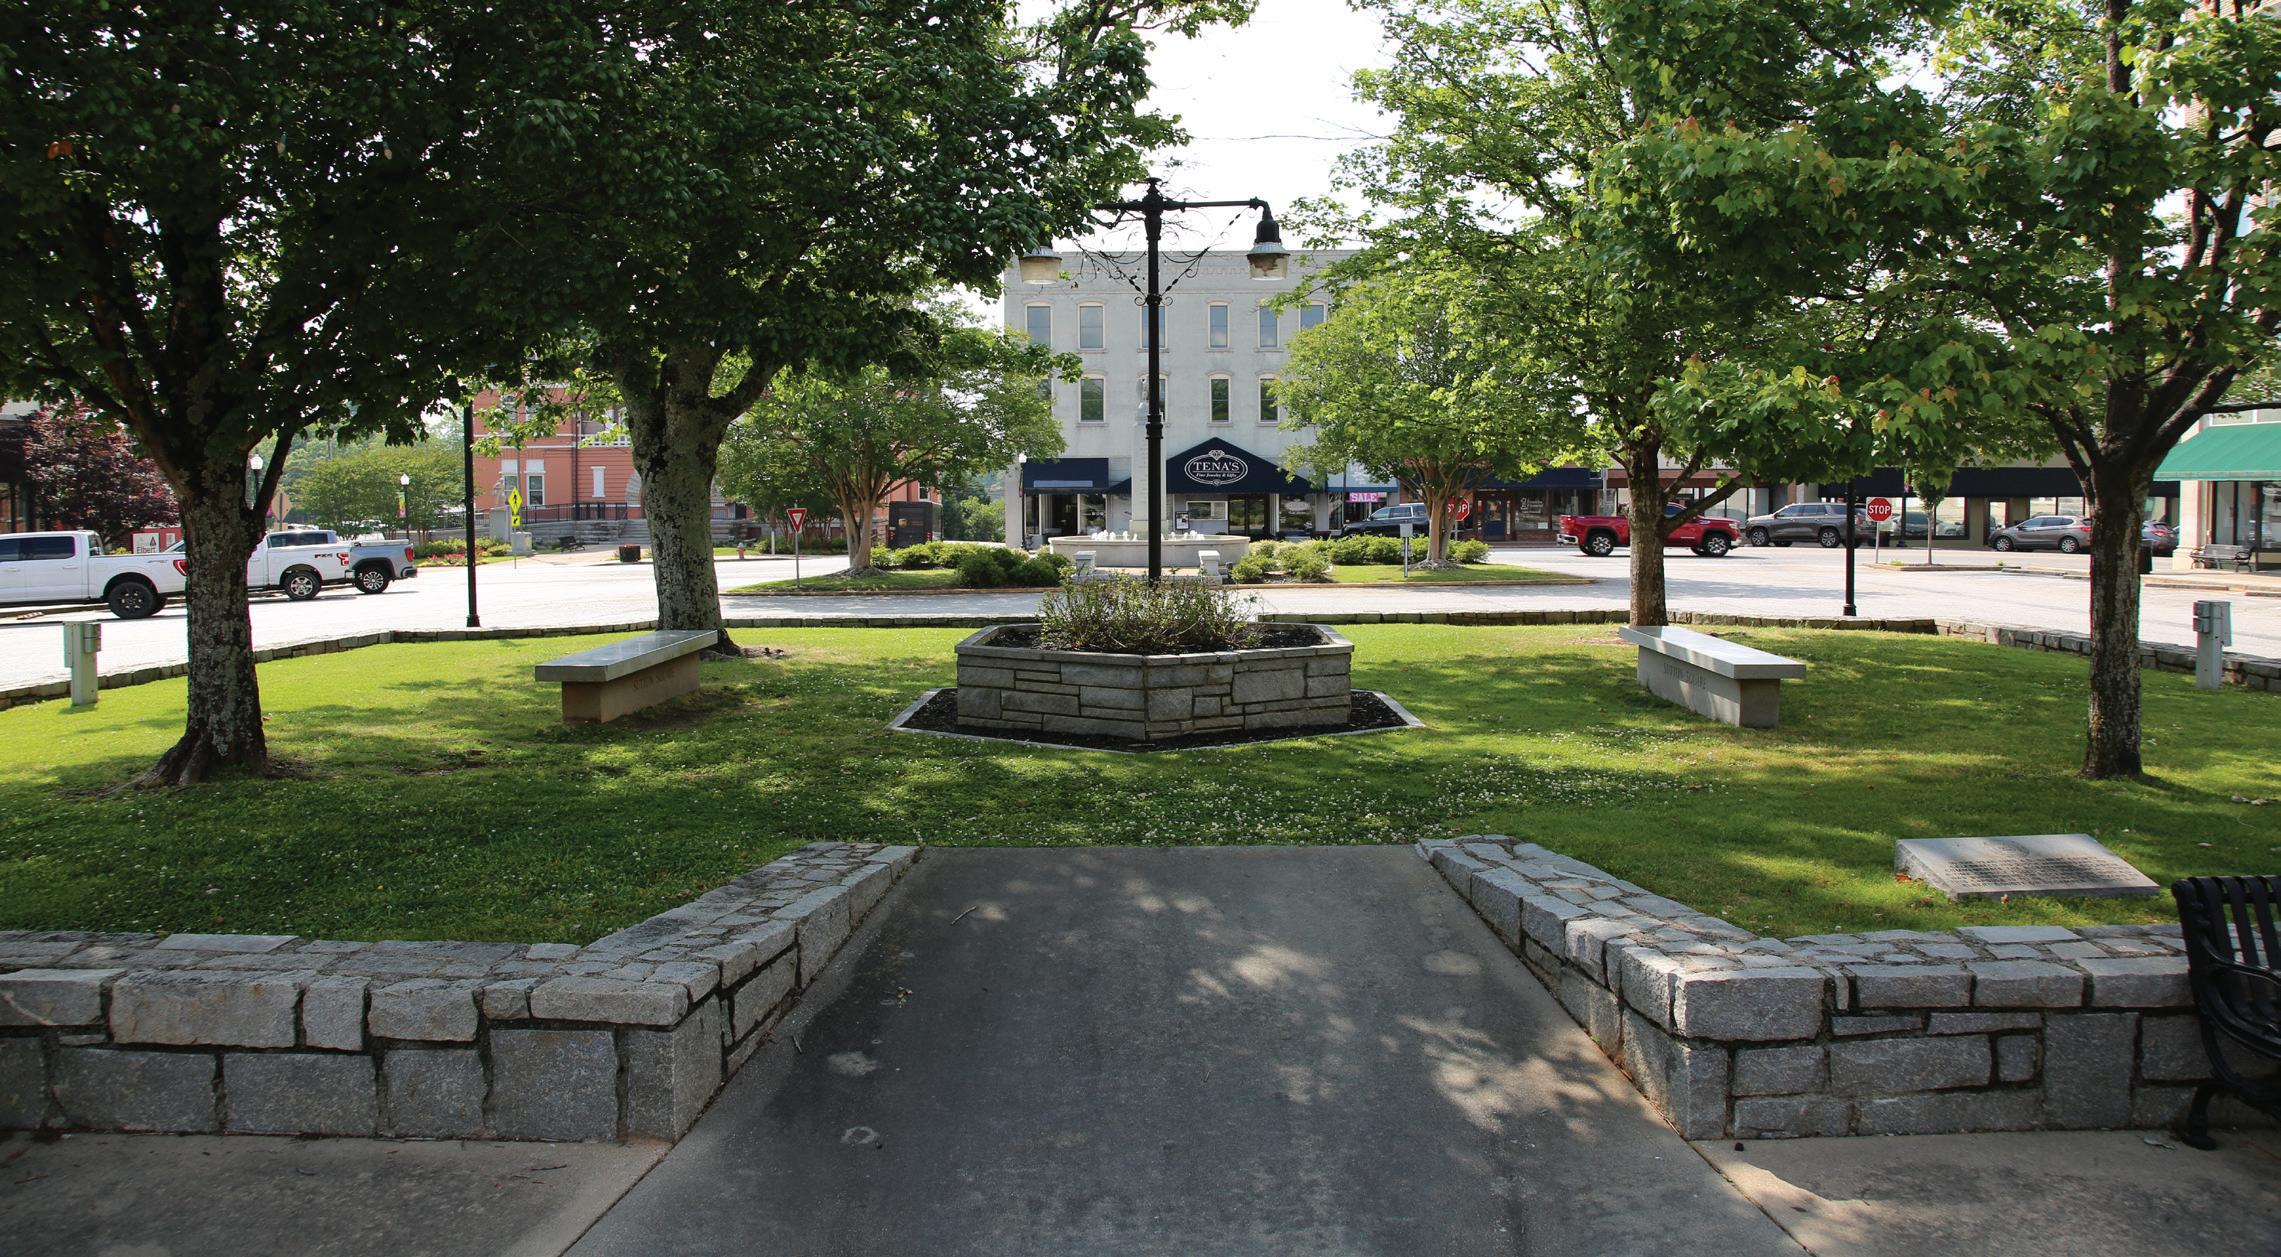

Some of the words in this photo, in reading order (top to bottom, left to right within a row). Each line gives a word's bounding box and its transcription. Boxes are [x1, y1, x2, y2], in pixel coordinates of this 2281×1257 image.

[1193, 461, 1240, 471] TENA'S
[1351, 492, 1377, 502] SALE
[1868, 505, 1891, 514] STOP
